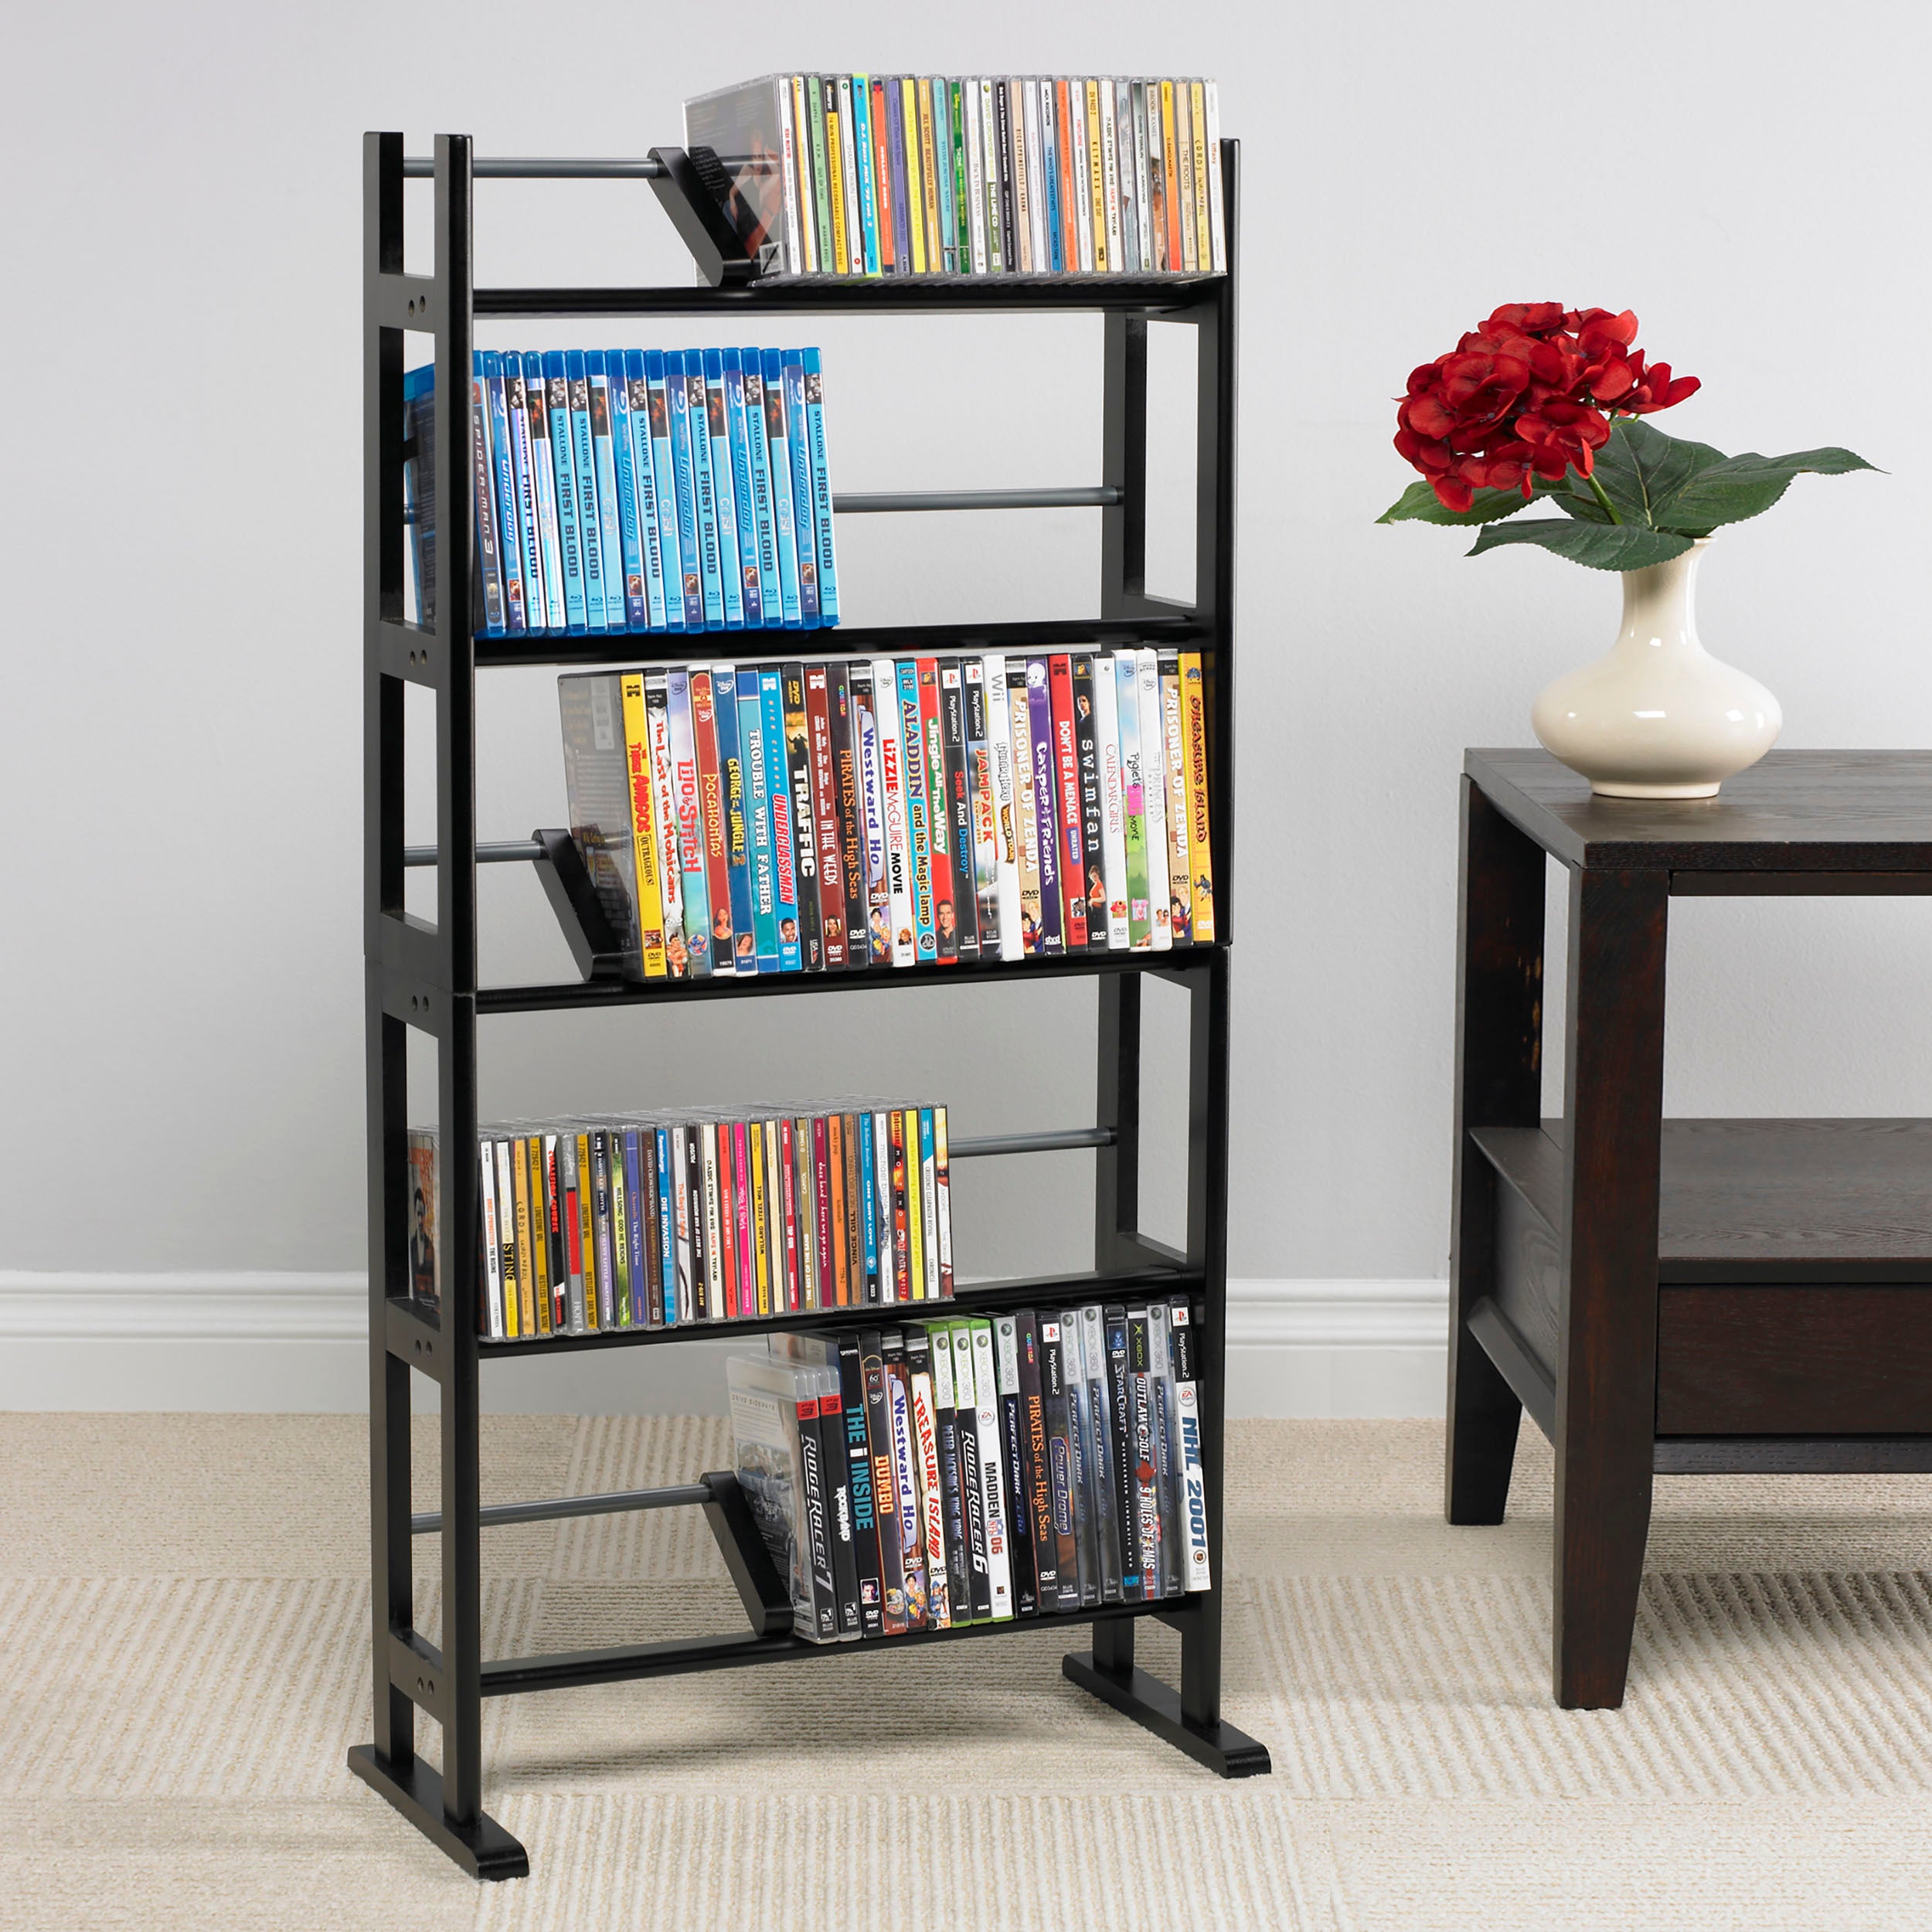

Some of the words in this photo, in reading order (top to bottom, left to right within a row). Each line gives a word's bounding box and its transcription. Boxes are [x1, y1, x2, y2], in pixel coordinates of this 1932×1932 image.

[556, 416, 568, 466] STALLONE
[580, 419, 590, 469] STALLONE
[639, 417, 649, 468] STALLONE
[698, 413, 708, 464] STALLONE
[752, 413, 763, 462] STALLONE
[815, 410, 824, 461] STALLONE
[560, 473, 573, 519] FIRST
[582, 476, 595, 519] FIRST
[642, 474, 655, 519] FIRST
[701, 471, 713, 516] FIRST
[755, 469, 768, 514] FIRST
[817, 468, 828, 512] FIRST
[566, 525, 578, 578] BLOOD
[587, 528, 600, 580] BLOOD
[647, 526, 660, 578] BLOOD
[704, 522, 717, 574] BLOOD
[760, 520, 773, 572] BLOOD
[821, 518, 832, 570] BLOOD
[992, 674, 1004, 702] Wii
[903, 700, 923, 798] ALADDIN
[928, 719, 942, 770] Jingle
[1013, 700, 1029, 784] PRISONER
[1166, 687, 1182, 770] PRISONER
[655, 746, 667, 773] Last
[728, 758, 741, 800] GEORGE
[749, 730, 763, 799] TROUBLE
[839, 750, 853, 806] PIRATES
[863, 728, 878, 828] Westward
[1062, 755, 1073, 768] BE
[1063, 771, 1073, 780] A
[631, 774, 651, 833] AMIGOS
[660, 785, 670, 798] of
[954, 771, 965, 799] Seek
[975, 749, 992, 842] JAMPACK
[1022, 792, 1033, 811] OF
[1063, 782, 1078, 824] MENACE
[1080, 740, 1100, 852] swimfan
[1173, 777, 1184, 797] OF
[662, 801, 672, 821] the
[703, 774, 722, 857] POCAHONTAS
[730, 809, 743, 852] JUNGLE
[755, 807, 767, 846] WITH
[794, 765, 815, 877] TRAFFIC
[821, 820, 834, 830] IN
[845, 809, 853, 818] of
[846, 821, 855, 835] the
[913, 804, 925, 828] and
[957, 802, 967, 825] And
[1175, 803, 1189, 859] ZENDA
[662, 823, 677, 904] Mohicans
[773, 794, 794, 905] UNDERCLASSMAN
[822, 832, 835, 850] THE
[845, 838, 859, 869] High
[870, 836, 882, 865] Ho
[914, 832, 927, 851] the
[1023, 817, 1037, 873] ZENDA
[757, 854, 771, 915] FATHER
[822, 854, 838, 886] WEEDS
[848, 872, 859, 900] Seas
[891, 852, 903, 894] MOVIE
[913, 855, 929, 892] Magic
[917, 895, 932, 925] lamp
[846, 1403, 863, 1443] THE
[1029, 1396, 1043, 1451] PIRATES
[1182, 1417, 1201, 1468] NHL
[894, 1395, 911, 1495] Westward
[903, 1505, 915, 1530] Ho
[914, 1392, 937, 1492] TREASURE
[928, 1498, 940, 1561] ISLAND
[1034, 1453, 1043, 1462] of
[1036, 1465, 1044, 1479] the
[851, 1462, 871, 1531] INSIDE
[875, 1454, 892, 1514] DUMBO
[985, 1462, 1001, 1519] MADDEN
[1034, 1481, 1048, 1512] High
[1037, 1515, 1049, 1542] Seas
[1188, 1480, 1206, 1548] 2001
[973, 1554, 988, 1574] 6
[991, 1537, 1002, 1554] 06
